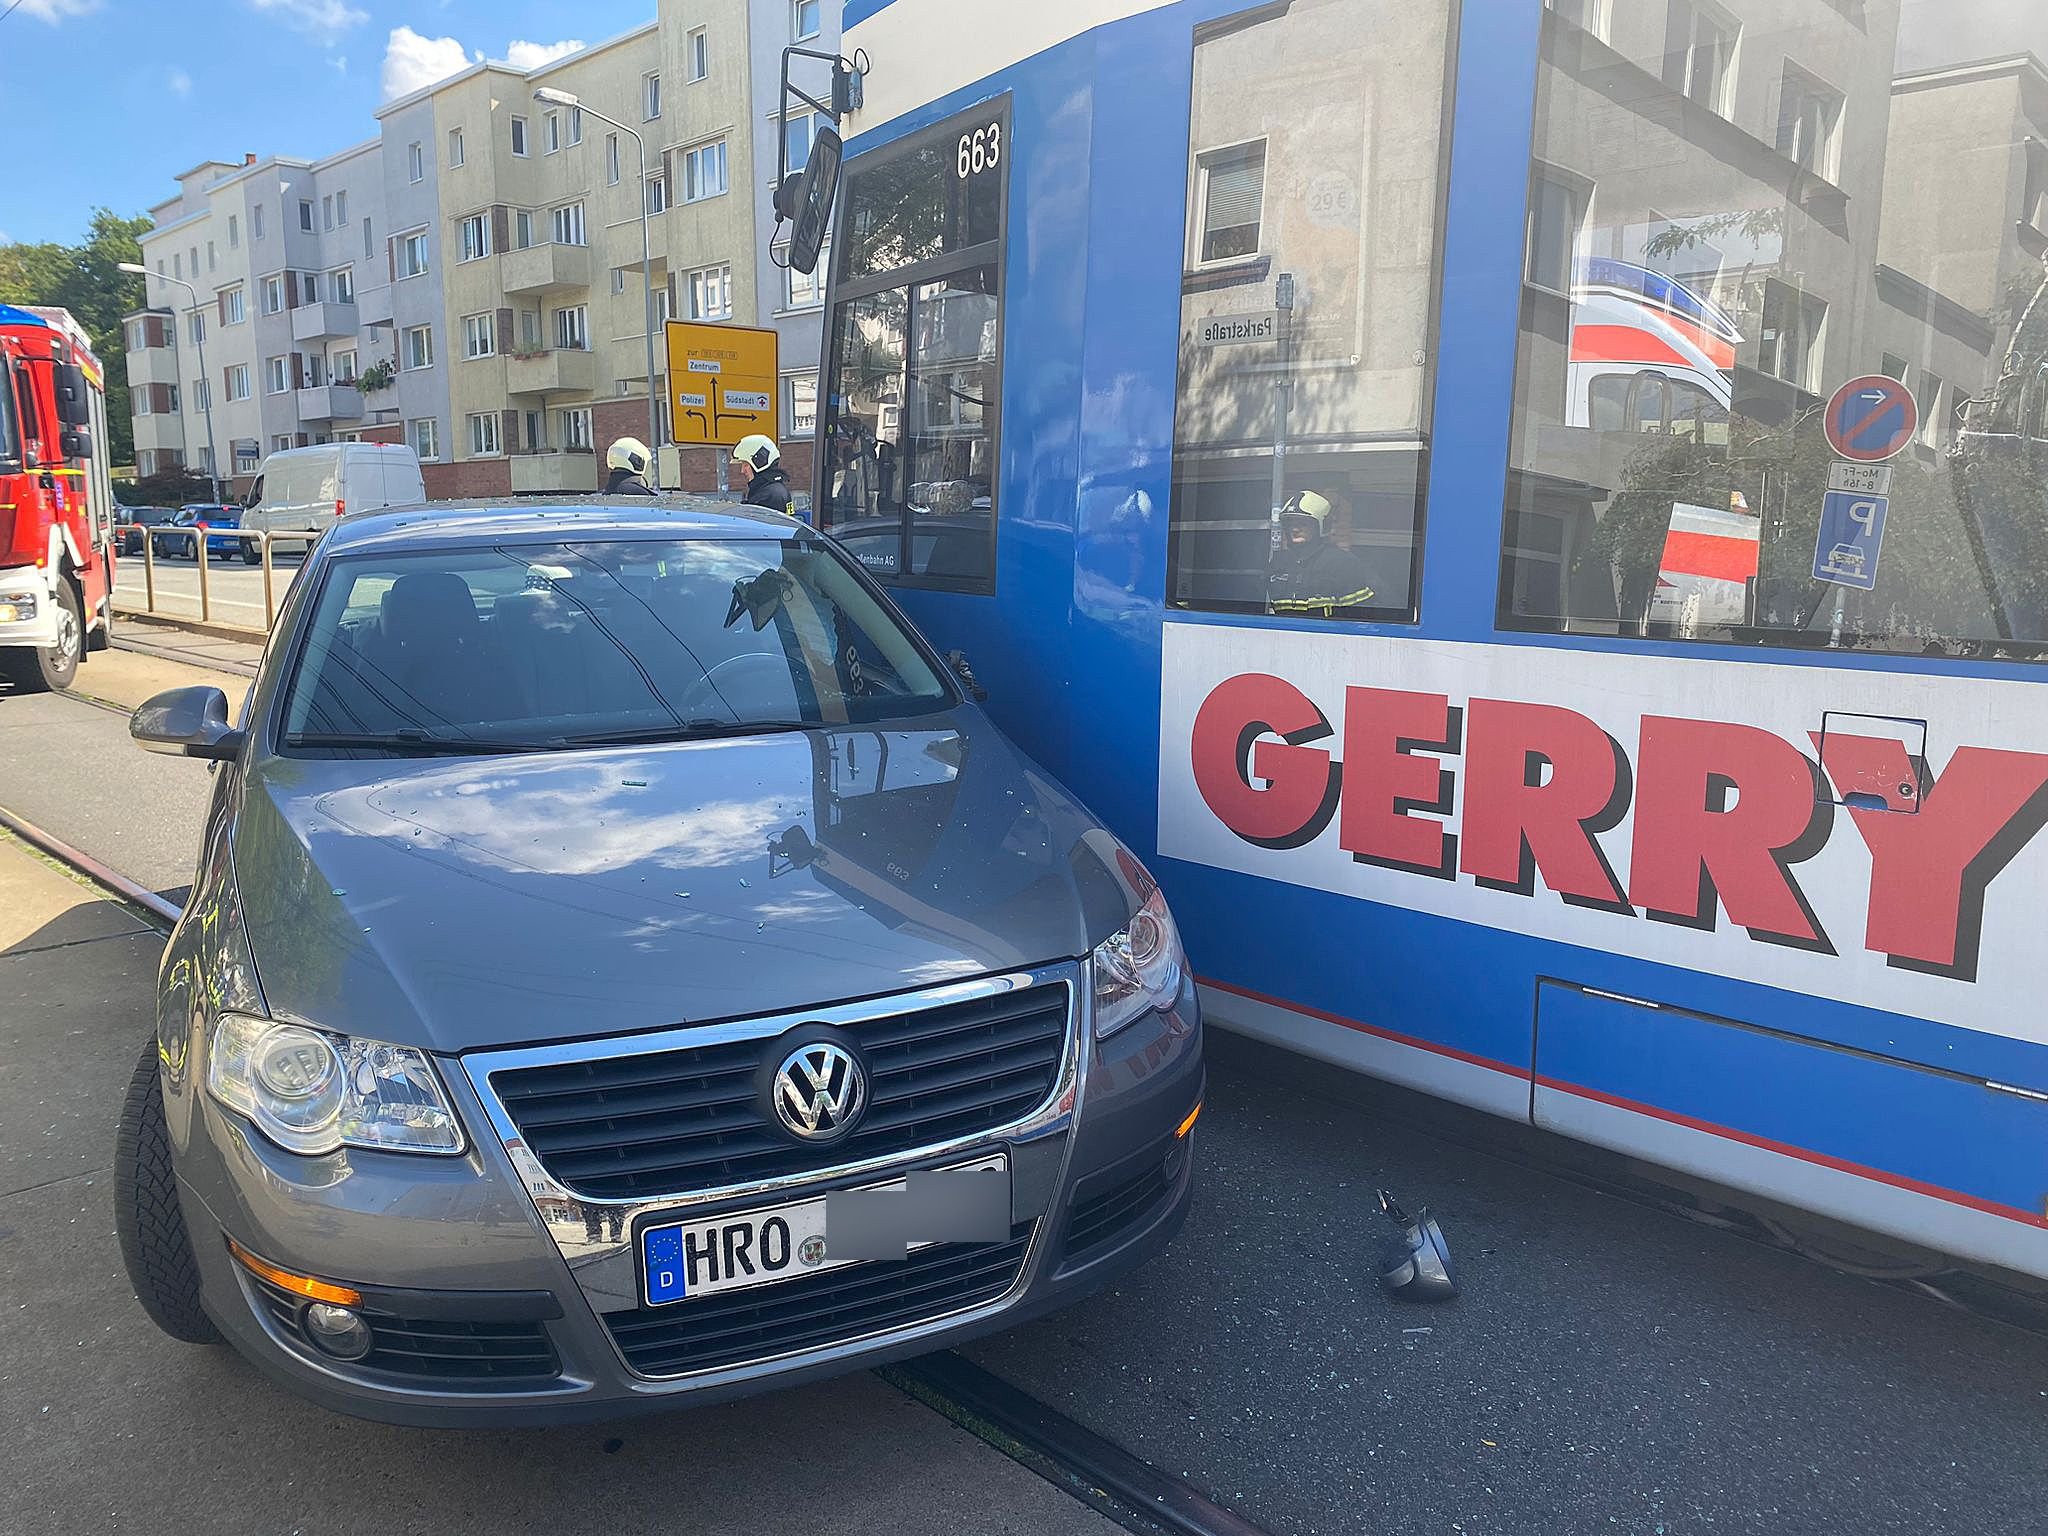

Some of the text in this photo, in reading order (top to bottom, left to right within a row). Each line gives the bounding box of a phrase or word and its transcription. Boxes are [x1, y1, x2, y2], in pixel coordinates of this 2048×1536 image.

[957, 121, 1000, 179] 663
[689, 361, 719, 372] Zentrum
[681, 395, 704, 405] Polizei
[725, 395, 755, 405] Südstadt
[884, 555, 895, 566] AG
[1191, 672, 2048, 982] GERRY
[660, 1216, 791, 1287] D HRO
